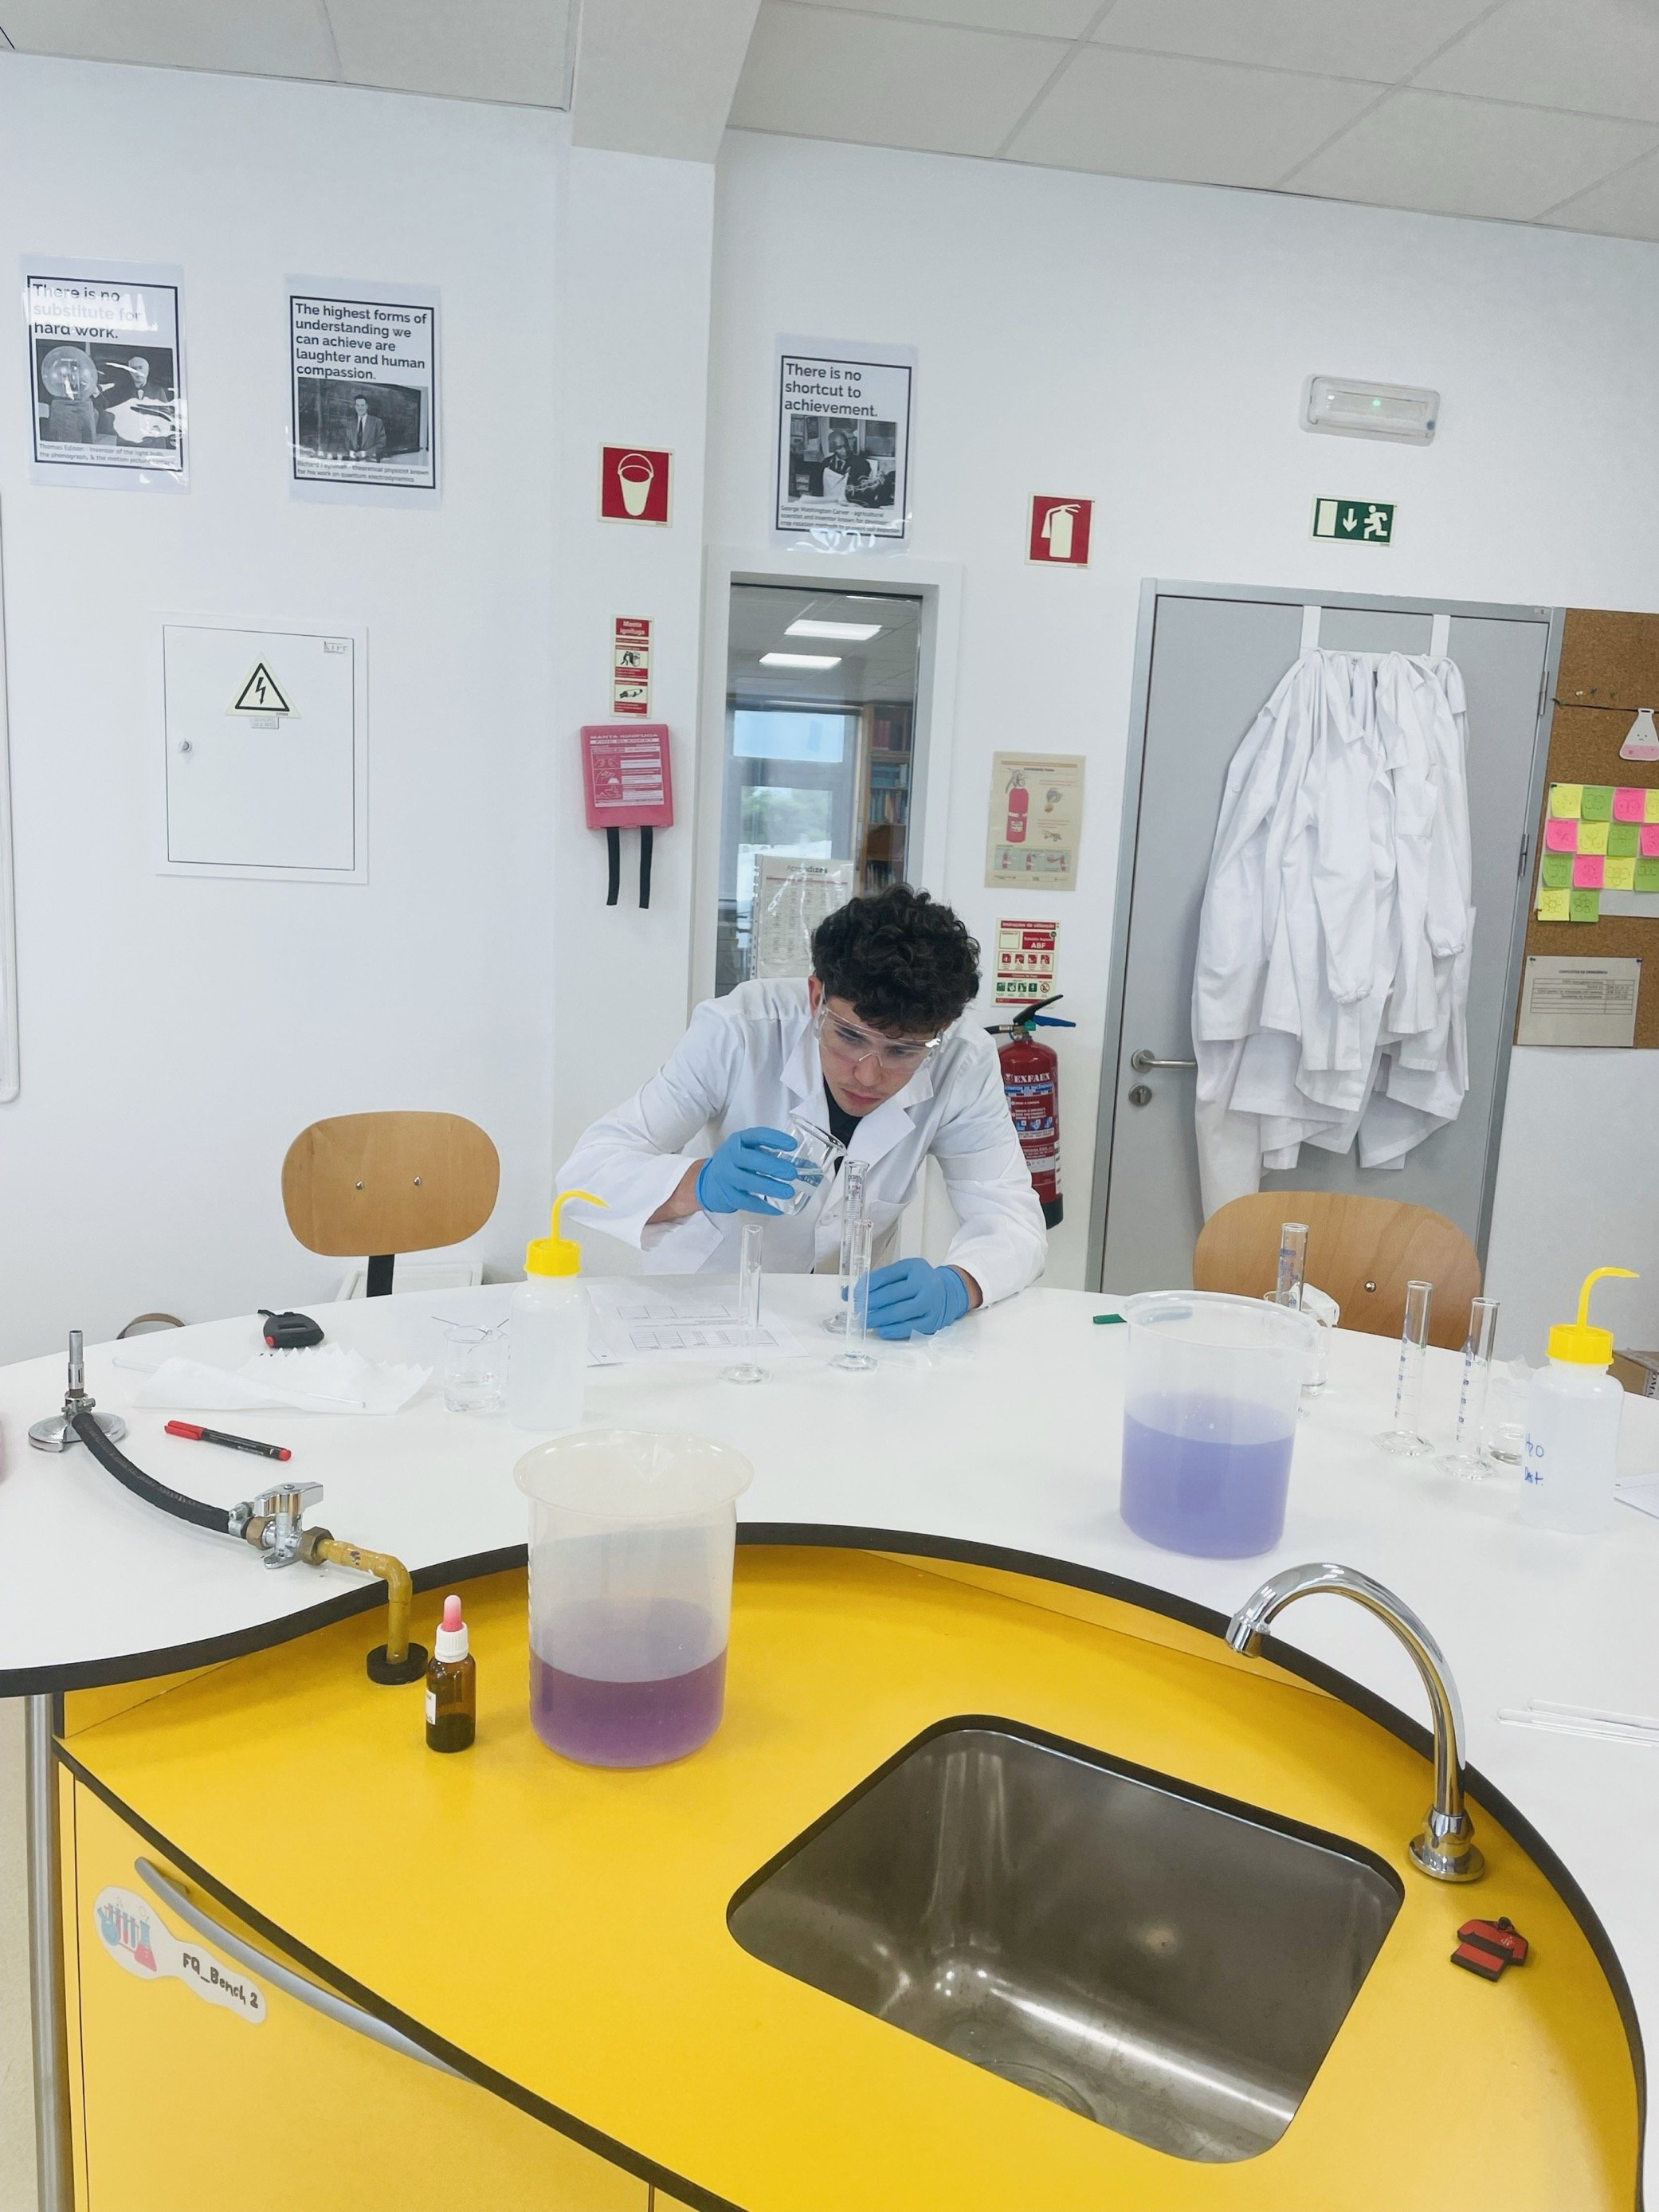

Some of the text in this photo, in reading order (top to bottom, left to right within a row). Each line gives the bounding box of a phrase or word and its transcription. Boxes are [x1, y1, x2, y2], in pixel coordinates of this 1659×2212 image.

[33, 283, 120, 302] There is no
[33, 302, 141, 322] substitute for
[295, 303, 427, 325] The highest forms of
[34, 322, 119, 339] hard work.
[296, 319, 411, 339] understanding we
[296, 335, 396, 351] can achieve are
[296, 348, 425, 369] laughter and human
[296, 365, 376, 380] compassion.
[786, 363, 861, 382] There is no
[785, 381, 861, 398] shortcut to
[784, 399, 878, 417] achievement.
[1014, 1073, 1051, 1083] EXFAEX
[250, 1992, 258, 2009] 2
